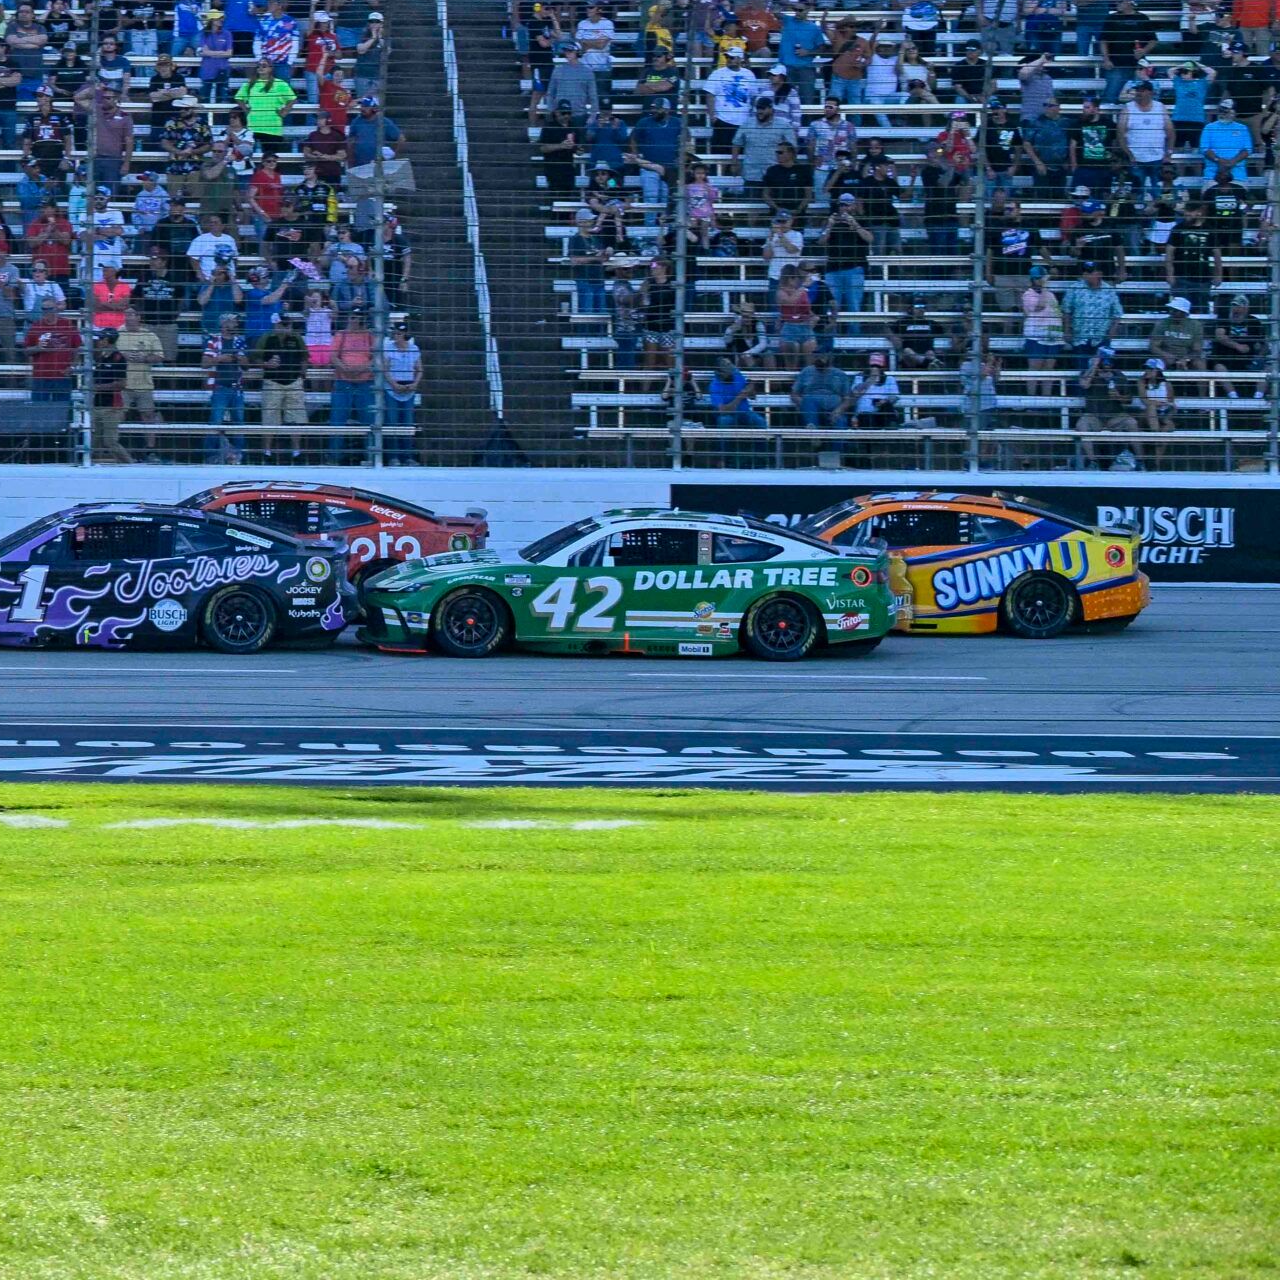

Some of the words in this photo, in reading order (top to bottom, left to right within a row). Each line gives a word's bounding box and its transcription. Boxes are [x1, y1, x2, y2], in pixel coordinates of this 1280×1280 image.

[369, 505, 407, 520] telcel
[1138, 547, 1205, 564] IGHT
[633, 568, 755, 591] DOLLAR
[762, 566, 837, 587] TREE
[7, 564, 50, 623] 1
[286, 586, 323, 594] JOCKEY
[530, 576, 624, 632] 42
[149, 608, 187, 620] BUSCH
[288, 609, 321, 618] Kubota
[837, 614, 863, 629] Fritos
